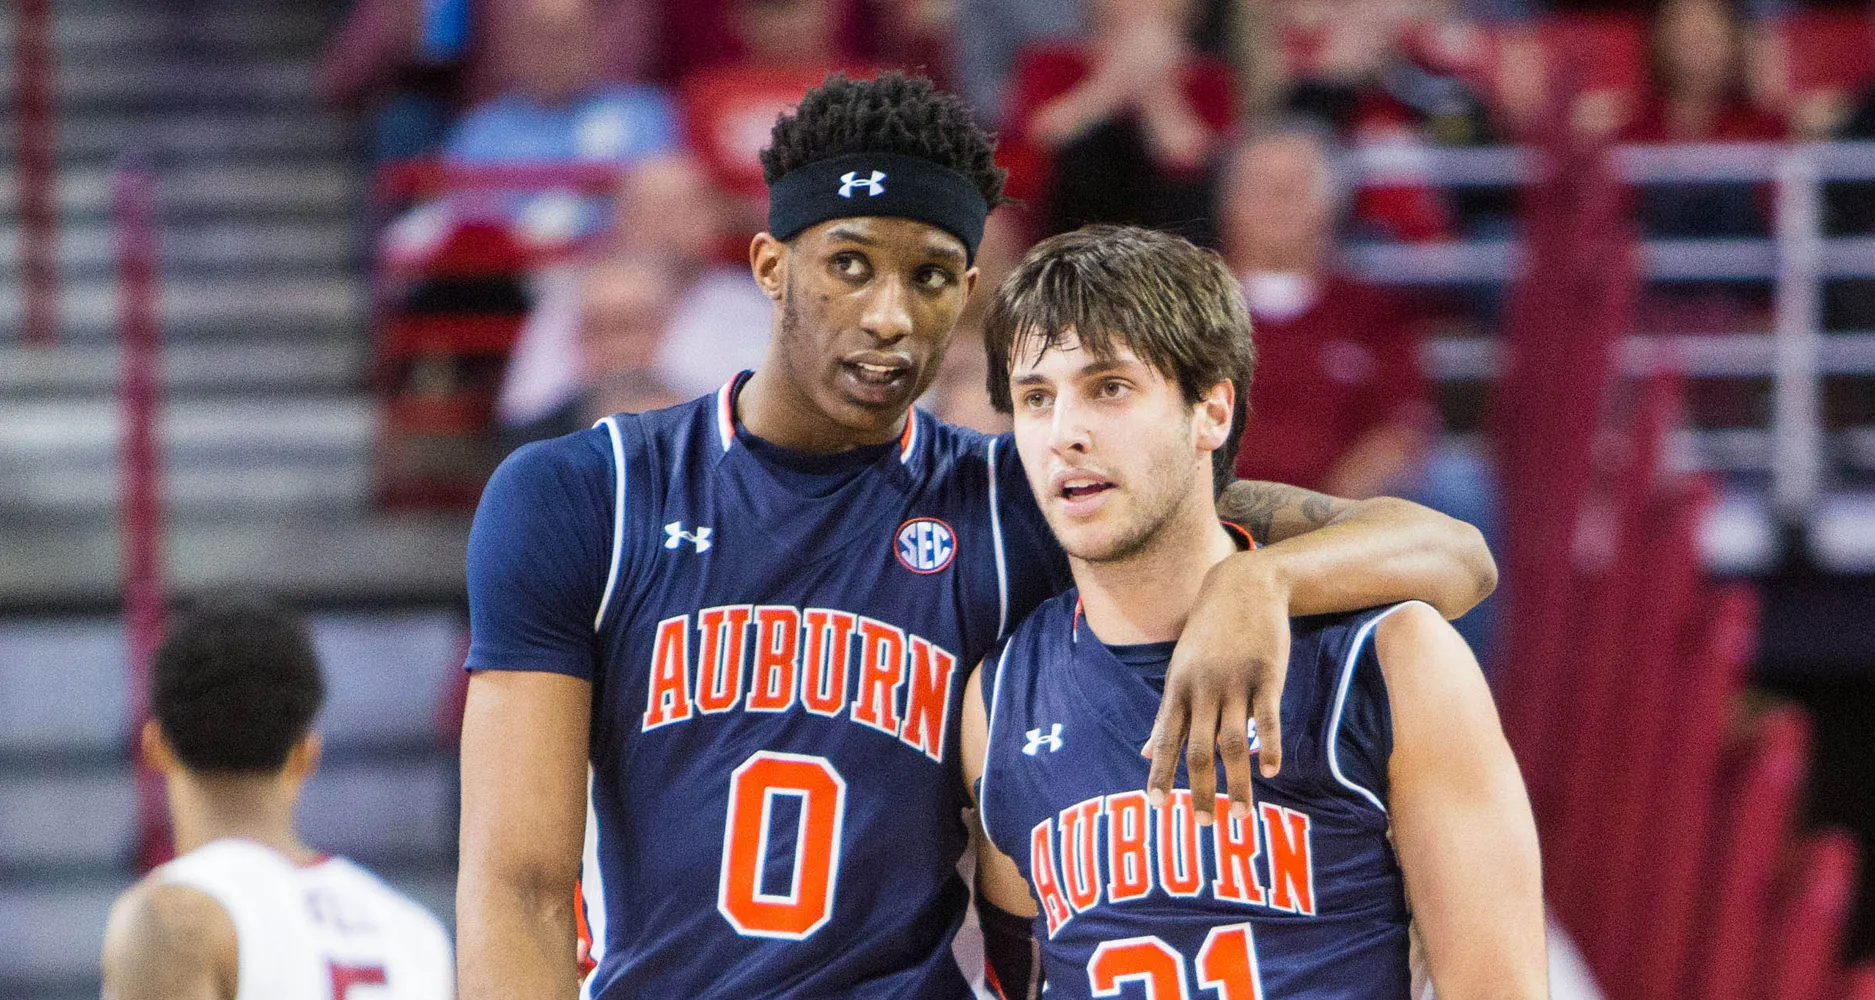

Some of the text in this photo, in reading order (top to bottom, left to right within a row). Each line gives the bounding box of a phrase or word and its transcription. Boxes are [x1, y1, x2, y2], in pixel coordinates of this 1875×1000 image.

[898, 521, 952, 569] SEC
[641, 603, 957, 763] AUBURN
[717, 750, 846, 940] 0
[1031, 788, 1316, 940] AUBURN
